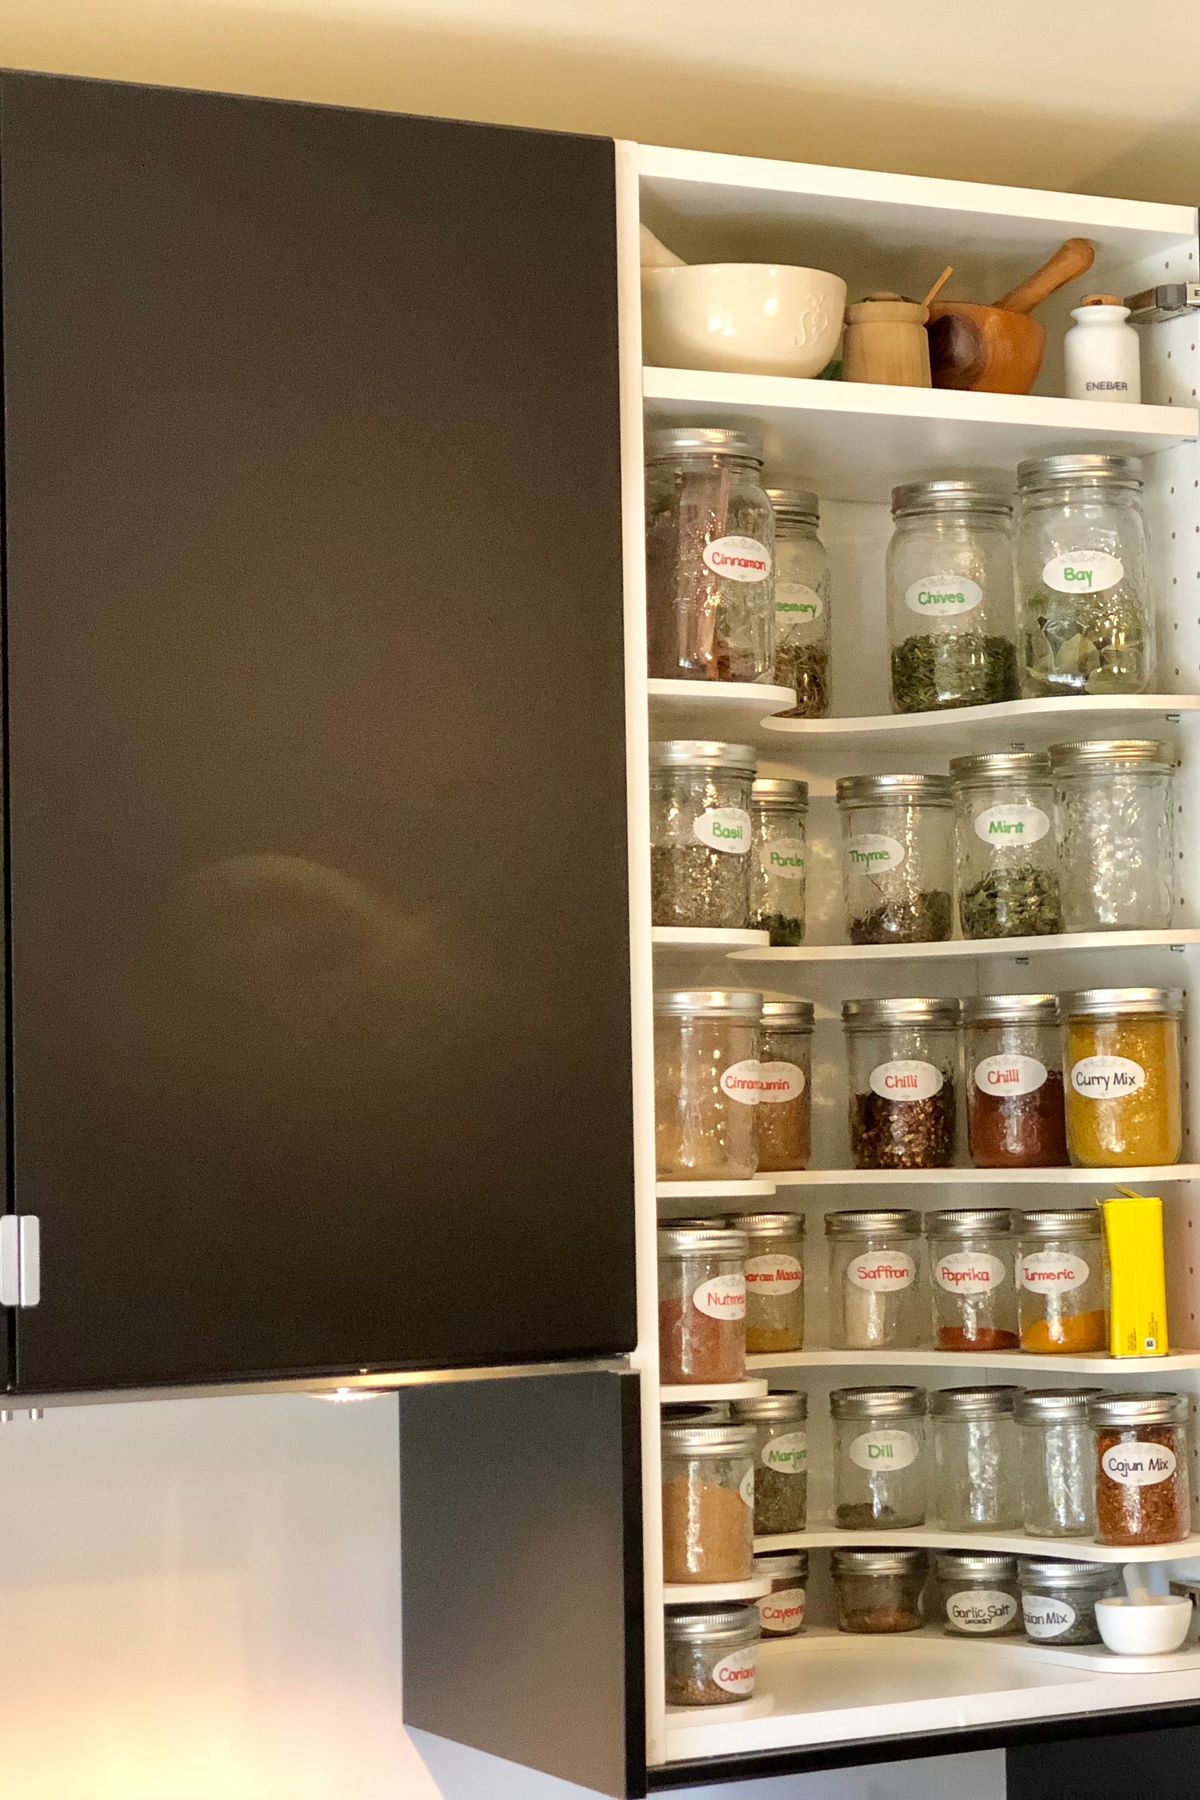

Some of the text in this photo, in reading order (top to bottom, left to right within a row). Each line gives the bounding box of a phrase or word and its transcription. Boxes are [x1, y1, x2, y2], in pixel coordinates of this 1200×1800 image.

[1086, 381, 1128, 391] ENEBÆR
[711, 551, 766, 571] Cinnamon
[1064, 567, 1093, 588] Bay
[918, 591, 966, 605] Chives
[712, 822, 743, 839] Basil
[988, 821, 1025, 834] Mint
[848, 849, 890, 868] Thyme
[885, 1074, 918, 1089] Chilli
[987, 1069, 1020, 1085] Chilli
[1075, 1071, 1136, 1091] Curry Mix
[857, 1265, 909, 1280] Saffron
[941, 1267, 990, 1286] Paprika
[1022, 1268, 1075, 1281] Turmeric
[867, 1444, 894, 1459] Dill
[1108, 1457, 1169, 1477] Cajun Mix
[952, 1603, 1010, 1618] Garlic Salt
[1046, 1611, 1069, 1625] Mix
